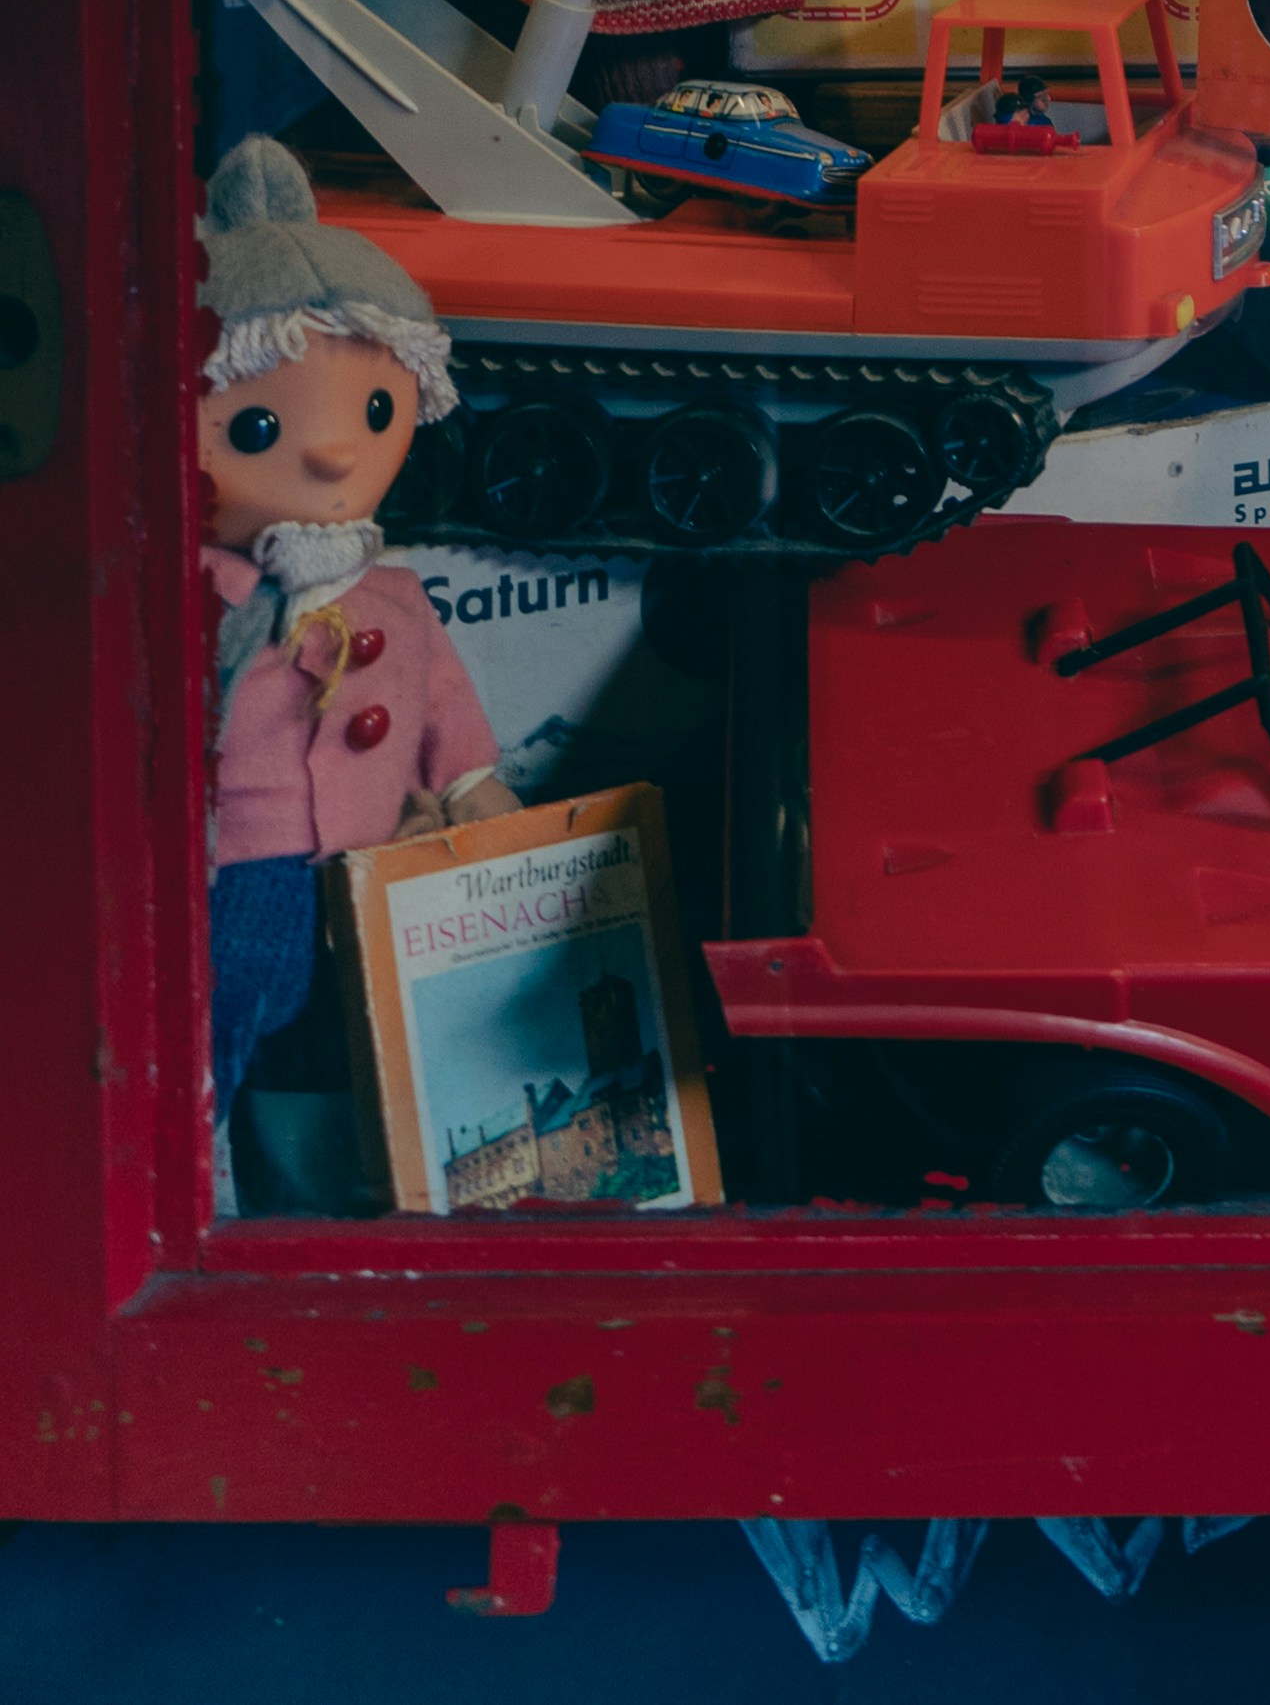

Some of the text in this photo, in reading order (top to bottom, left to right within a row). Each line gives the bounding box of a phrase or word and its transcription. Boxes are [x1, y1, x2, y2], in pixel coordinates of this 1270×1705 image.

[422, 568, 610, 627] Saturn
[454, 833, 633, 904] Wartburgstadt
[402, 884, 592, 958] EISENACH
